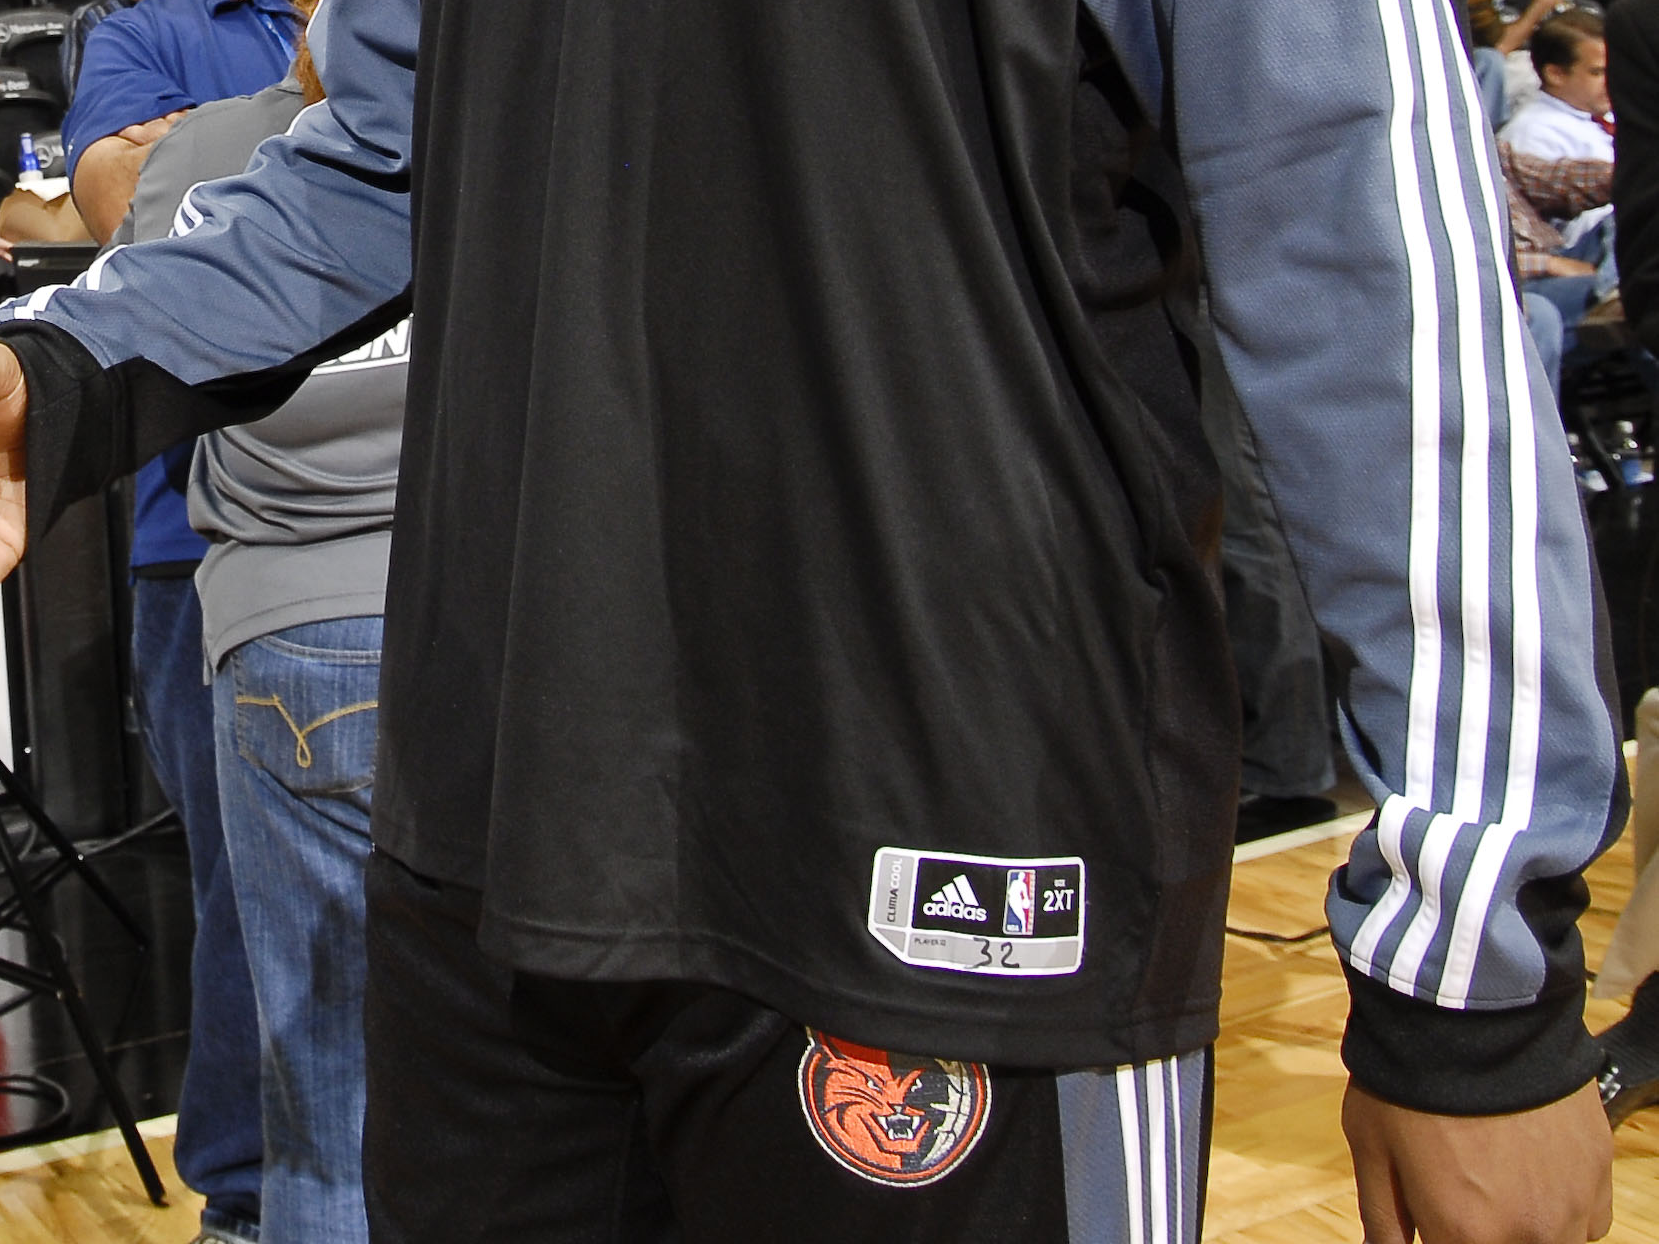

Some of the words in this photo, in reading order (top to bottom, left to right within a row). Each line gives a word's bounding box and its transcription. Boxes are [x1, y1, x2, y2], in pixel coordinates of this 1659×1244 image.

[922, 899, 988, 922] adidas
[1043, 888, 1075, 912] 2XT
[964, 937, 1020, 969] 32
